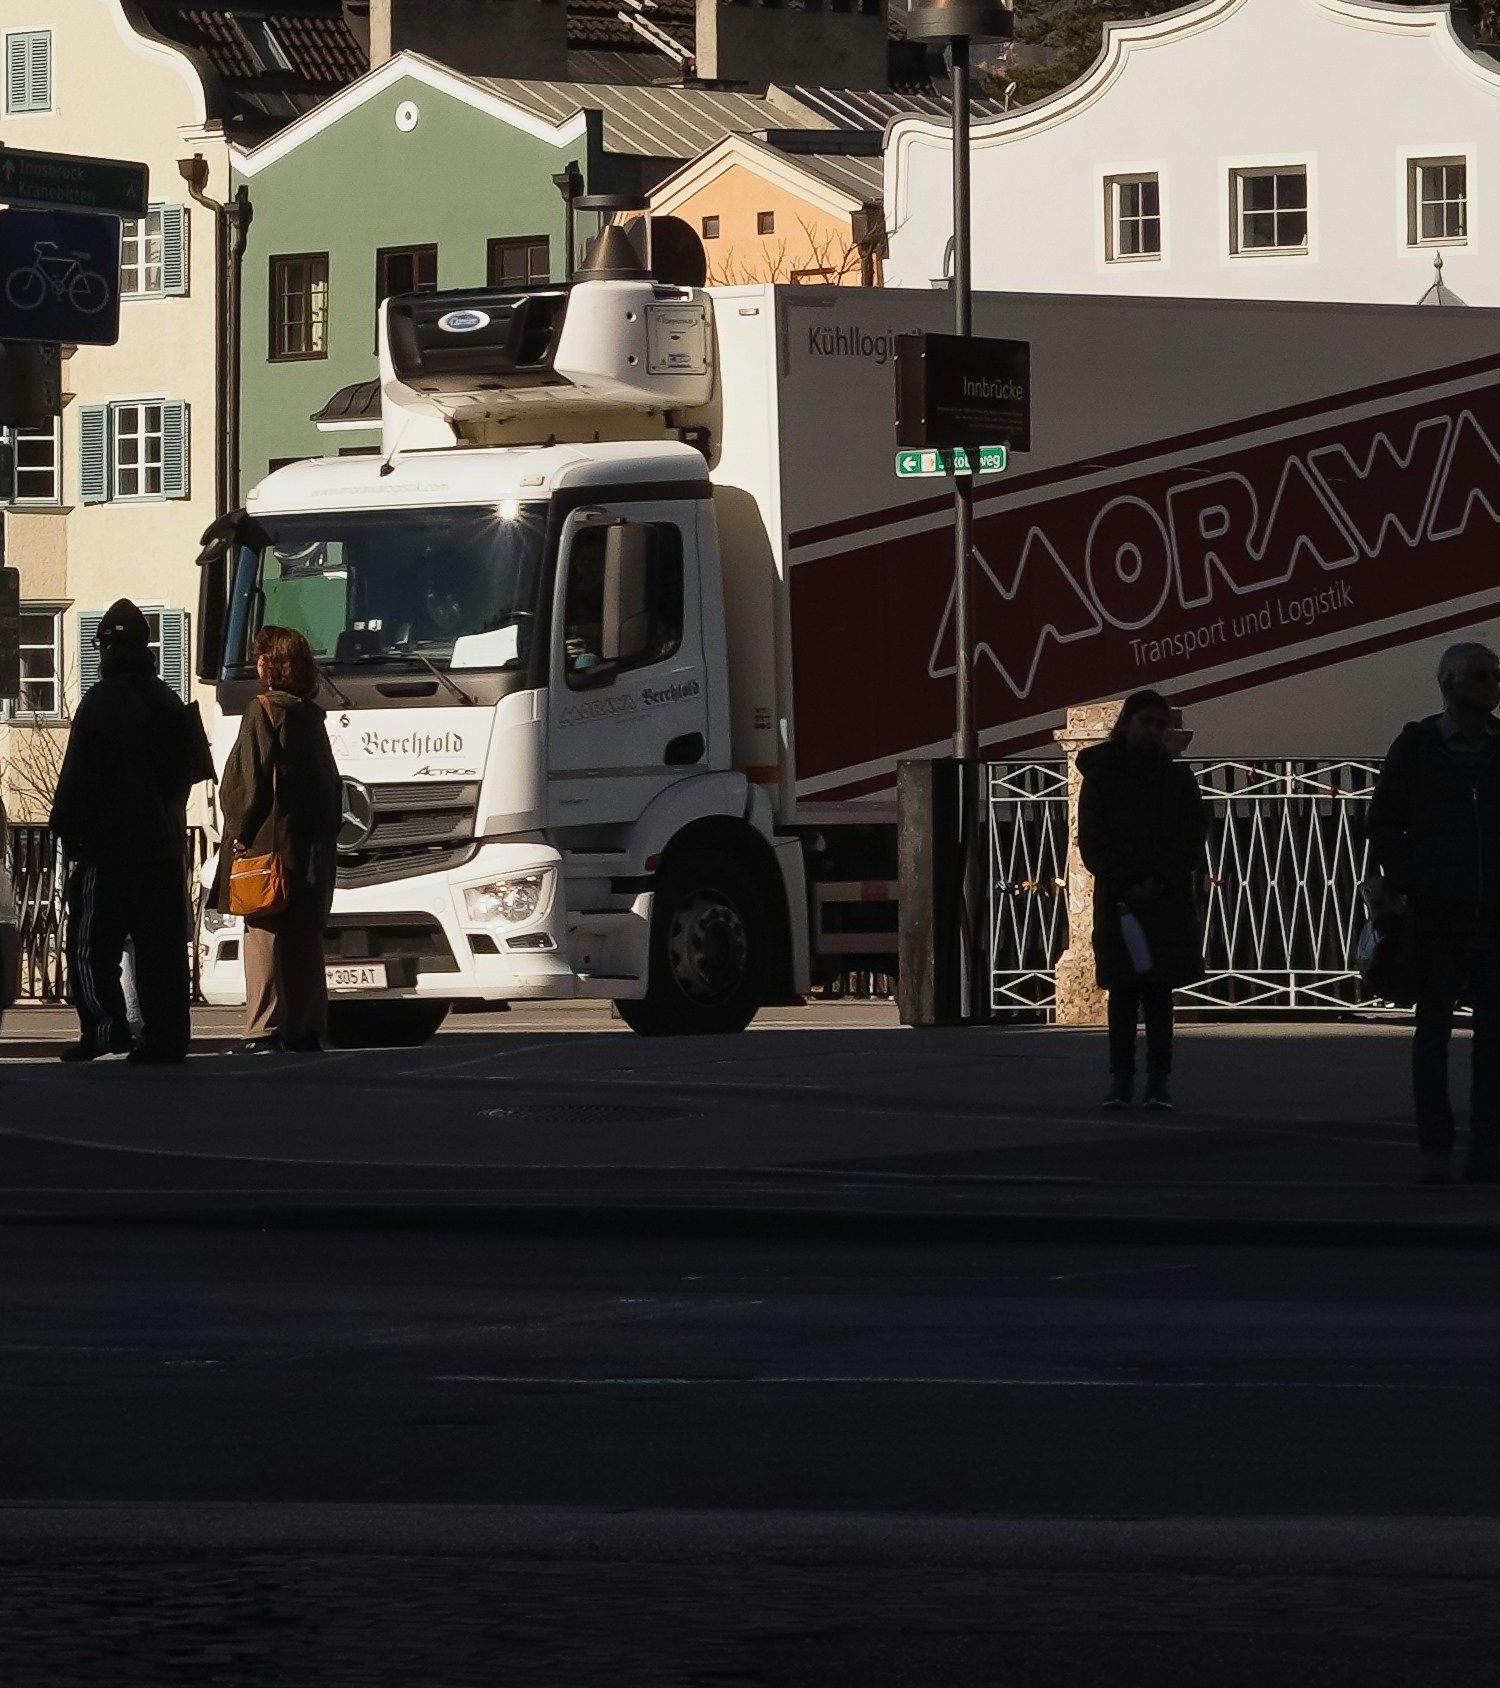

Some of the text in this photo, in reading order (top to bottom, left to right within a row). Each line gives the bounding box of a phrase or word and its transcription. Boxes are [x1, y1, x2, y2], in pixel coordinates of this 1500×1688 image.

[19, 158, 85, 181] Innsbruck
[18, 181, 96, 206] Kranebitten
[962, 375, 1024, 400] Innbrücke
[1128, 578, 1355, 667] Transport und Logistik
[361, 731, 463, 758] Berchtold
[335, 968, 376, 985] 305 AT
